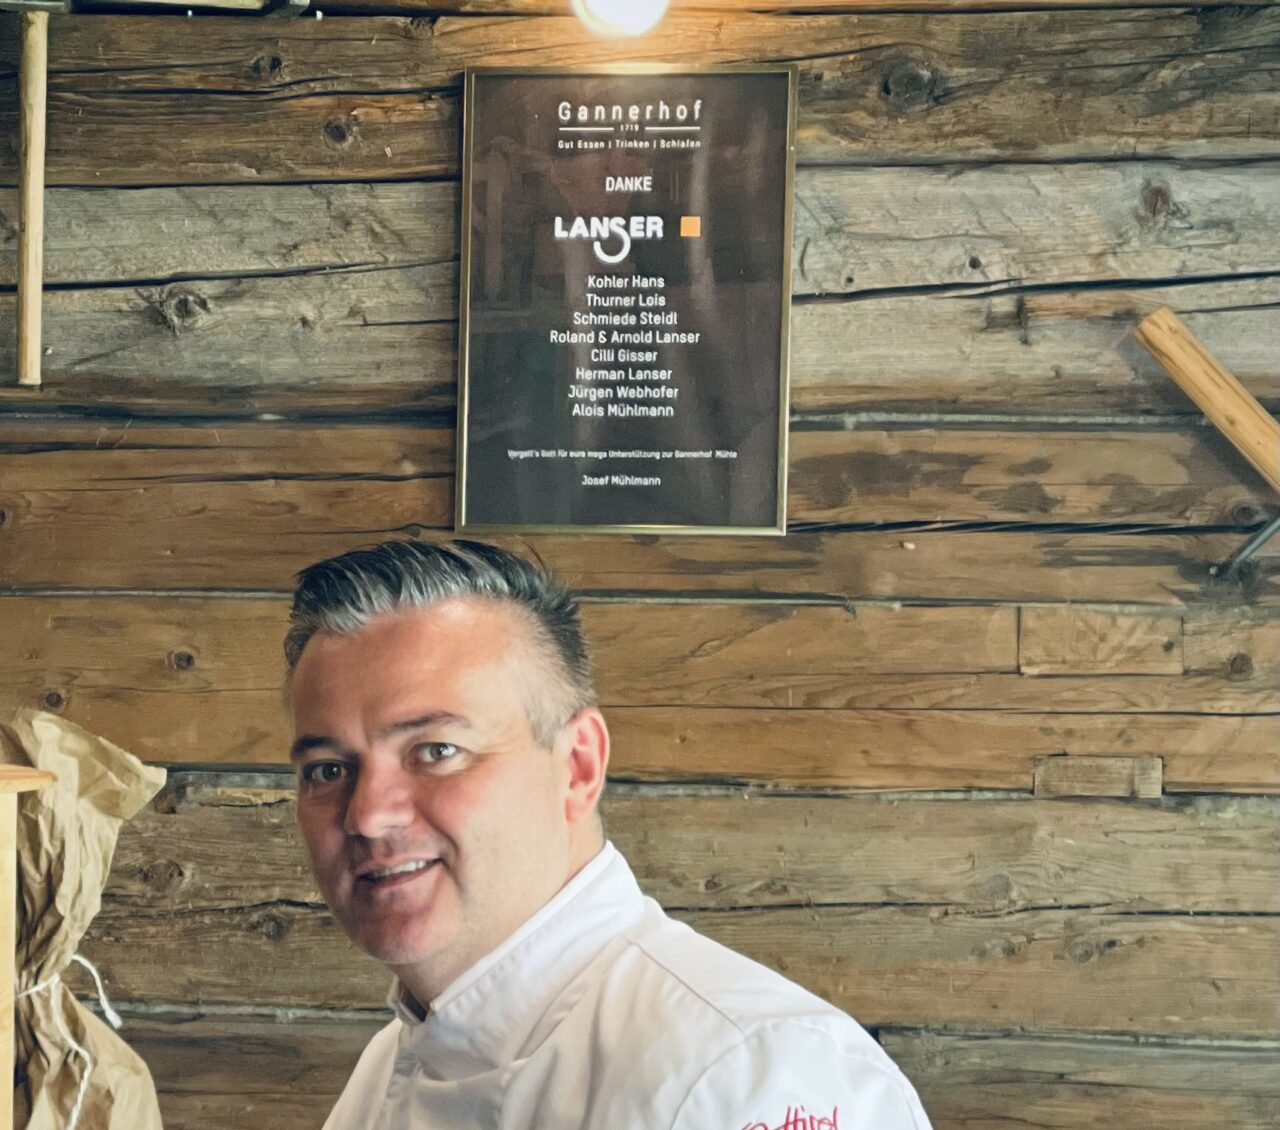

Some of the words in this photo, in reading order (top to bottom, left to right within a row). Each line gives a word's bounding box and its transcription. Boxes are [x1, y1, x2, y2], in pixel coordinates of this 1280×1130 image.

[558, 99, 702, 121] Gannerhof
[558, 140, 574, 149] Gut
[577, 140, 605, 149] Essen
[615, 139, 650, 149] Trinken
[660, 139, 701, 149] Schlafen
[605, 176, 653, 192] DANKE
[554, 215, 664, 263] LANSER
[587, 275, 629, 288] Kohler
[631, 275, 665, 288] Hans
[586, 293, 635, 307] Thurner
[638, 294, 666, 307] Lois
[573, 312, 637, 325] Schmiede
[639, 312, 678, 325] Steidl
[550, 330, 595, 343] Roland
[598, 330, 608, 343] &
[611, 330, 653, 344] Arnold
[655, 332, 701, 344] Lanser
[591, 349, 615, 362] Cilli
[617, 349, 658, 362] Gisser
[575, 367, 625, 380] Herman
[628, 367, 673, 381] Lanser
[568, 385, 613, 401] Jürgen
[616, 386, 679, 399] Webhofer
[572, 404, 605, 417] Alois
[607, 404, 674, 418] Mühlmann
[558, 449, 568, 458] für
[608, 450, 660, 460] Unterstützung
[582, 474, 609, 486] Josef
[611, 474, 661, 486] Mühlmann
